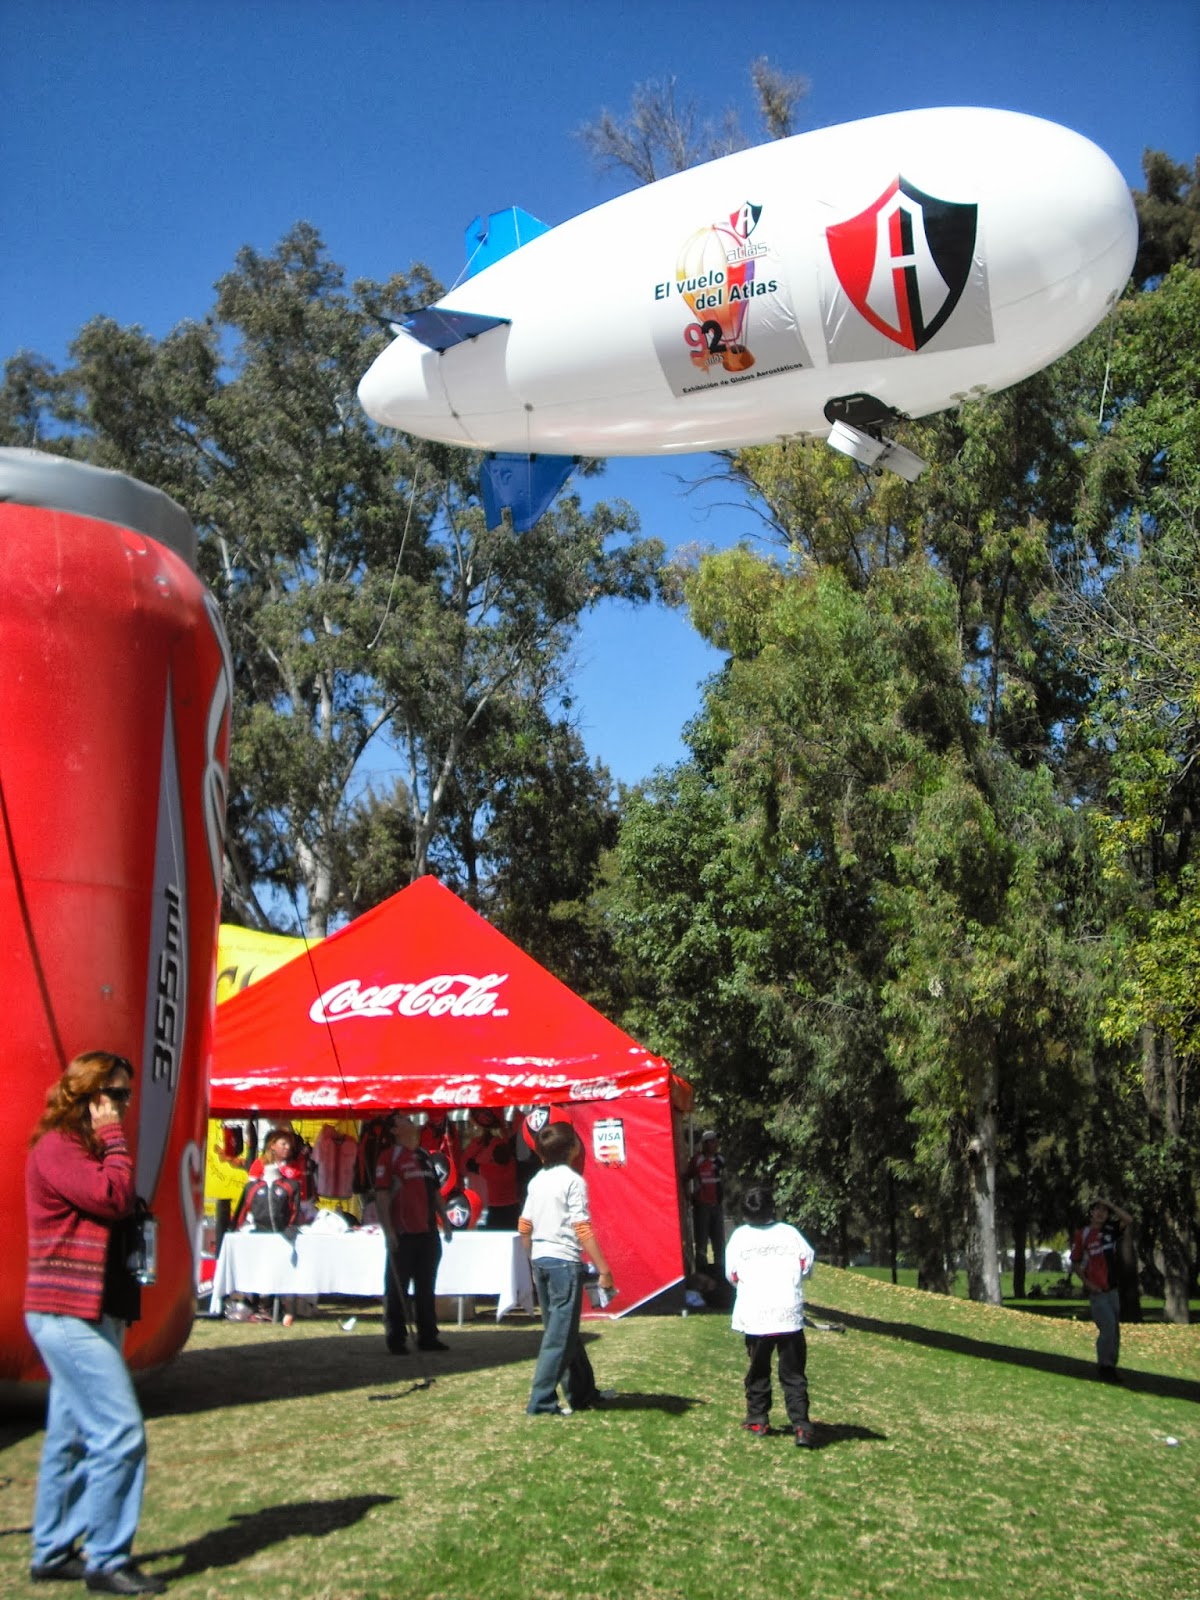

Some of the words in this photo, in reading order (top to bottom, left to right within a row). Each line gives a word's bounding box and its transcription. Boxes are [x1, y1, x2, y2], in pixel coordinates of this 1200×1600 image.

[654, 281, 670, 300] El
[676, 270, 725, 294] vuelo
[695, 288, 722, 310] del
[729, 279, 778, 302] Atlas
[683, 319, 727, 358] 92
[682, 381, 719, 394] Exhibición
[720, 378, 729, 386] de
[730, 373, 756, 384] Globos
[756, 362, 803, 378] Aerostáticos
[152, 883, 182, 1094] 355ml
[597, 1132, 621, 1142] VISA
